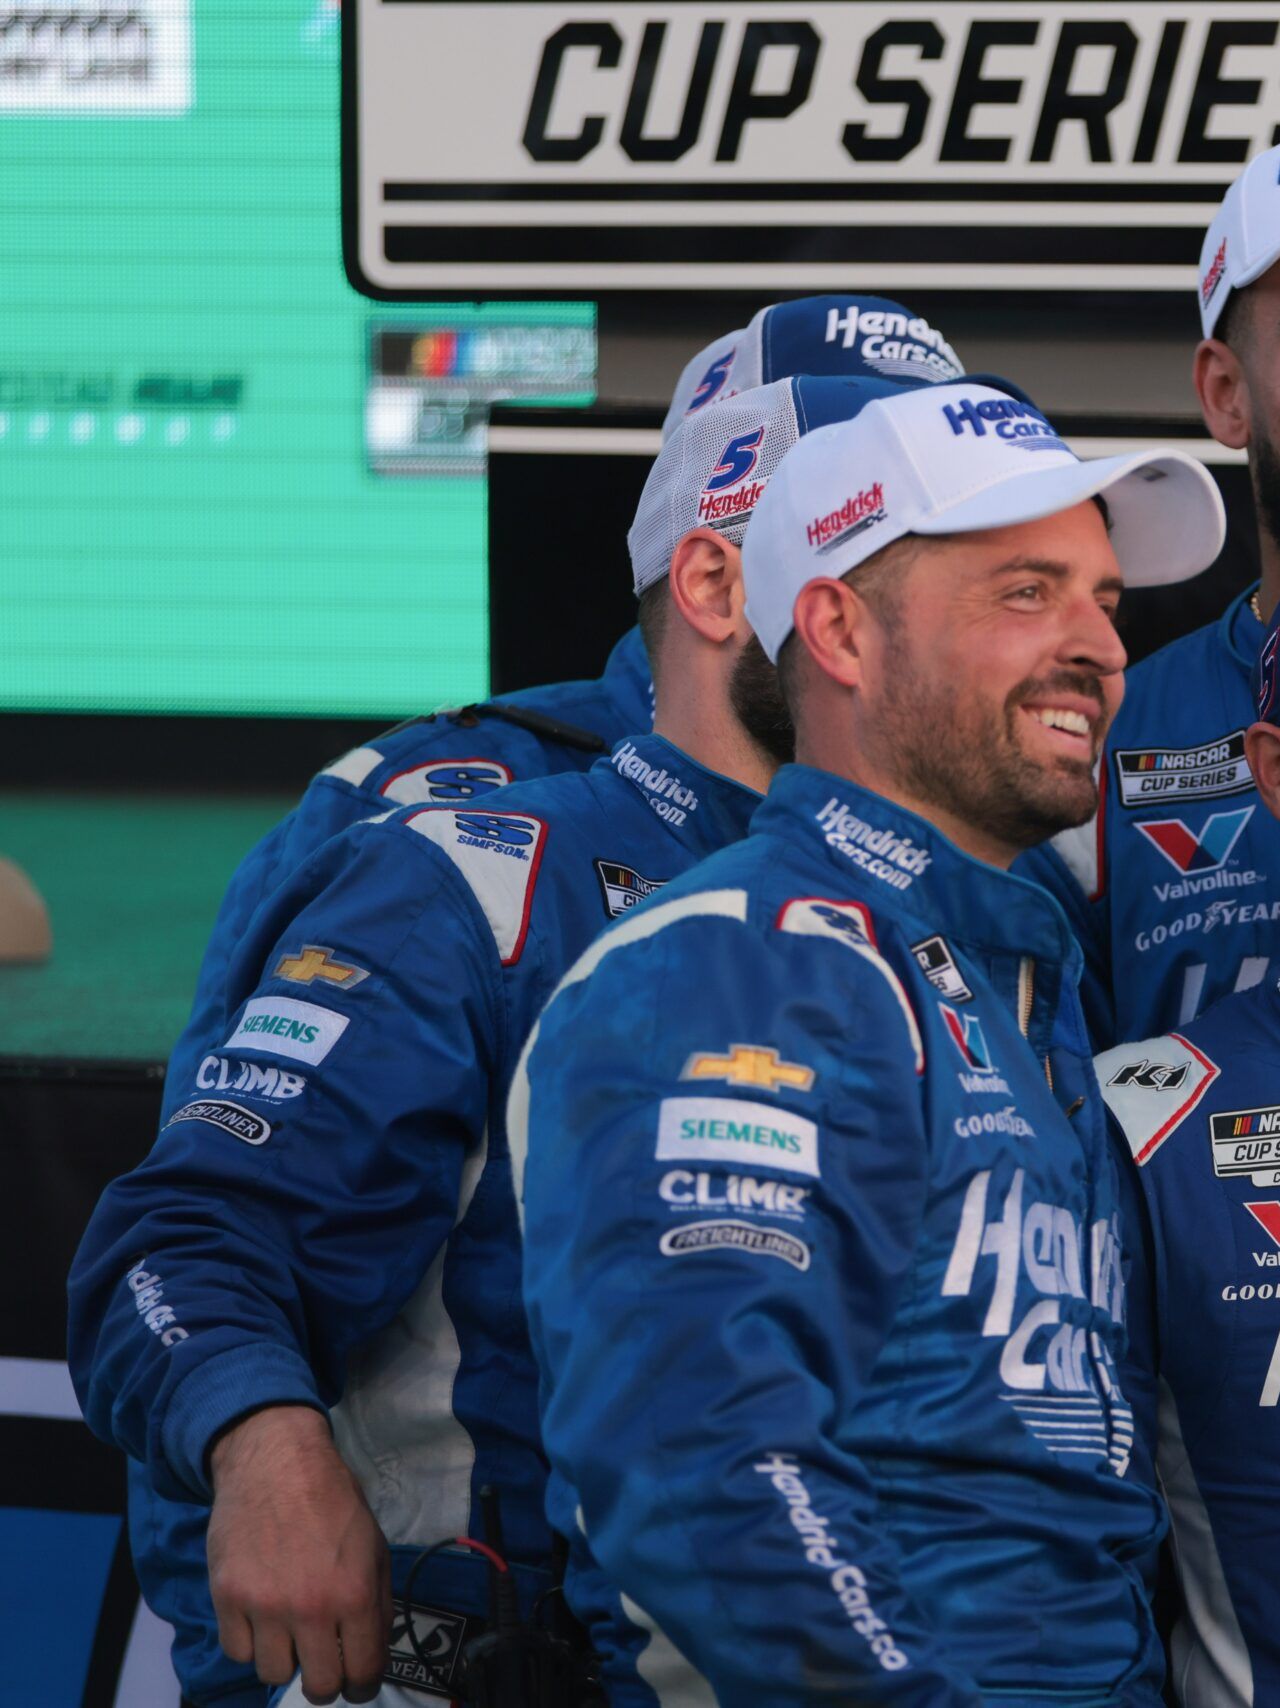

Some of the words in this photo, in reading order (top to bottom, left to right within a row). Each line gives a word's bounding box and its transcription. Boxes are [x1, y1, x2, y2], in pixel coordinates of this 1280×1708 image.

[522, 21, 821, 163] CUP
[684, 346, 737, 418] 5
[702, 425, 765, 495] 5
[698, 481, 765, 521] Hendric
[806, 482, 884, 547] Hendrick
[611, 742, 698, 811] Hendrick
[1162, 744, 1230, 770] NASCAR
[1141, 777, 1175, 792] CUP
[1178, 766, 1237, 789] SERIES
[457, 834, 527, 859] SIMPSON
[815, 798, 933, 876] Hendrick
[826, 833, 913, 890] Cars.com
[1153, 869, 1257, 902] Valvoline
[240, 1014, 320, 1044] SIEMENS
[196, 1055, 306, 1099] CLIMB
[680, 1119, 802, 1153] SIEMENS
[1234, 1142, 1272, 1161] CUP
